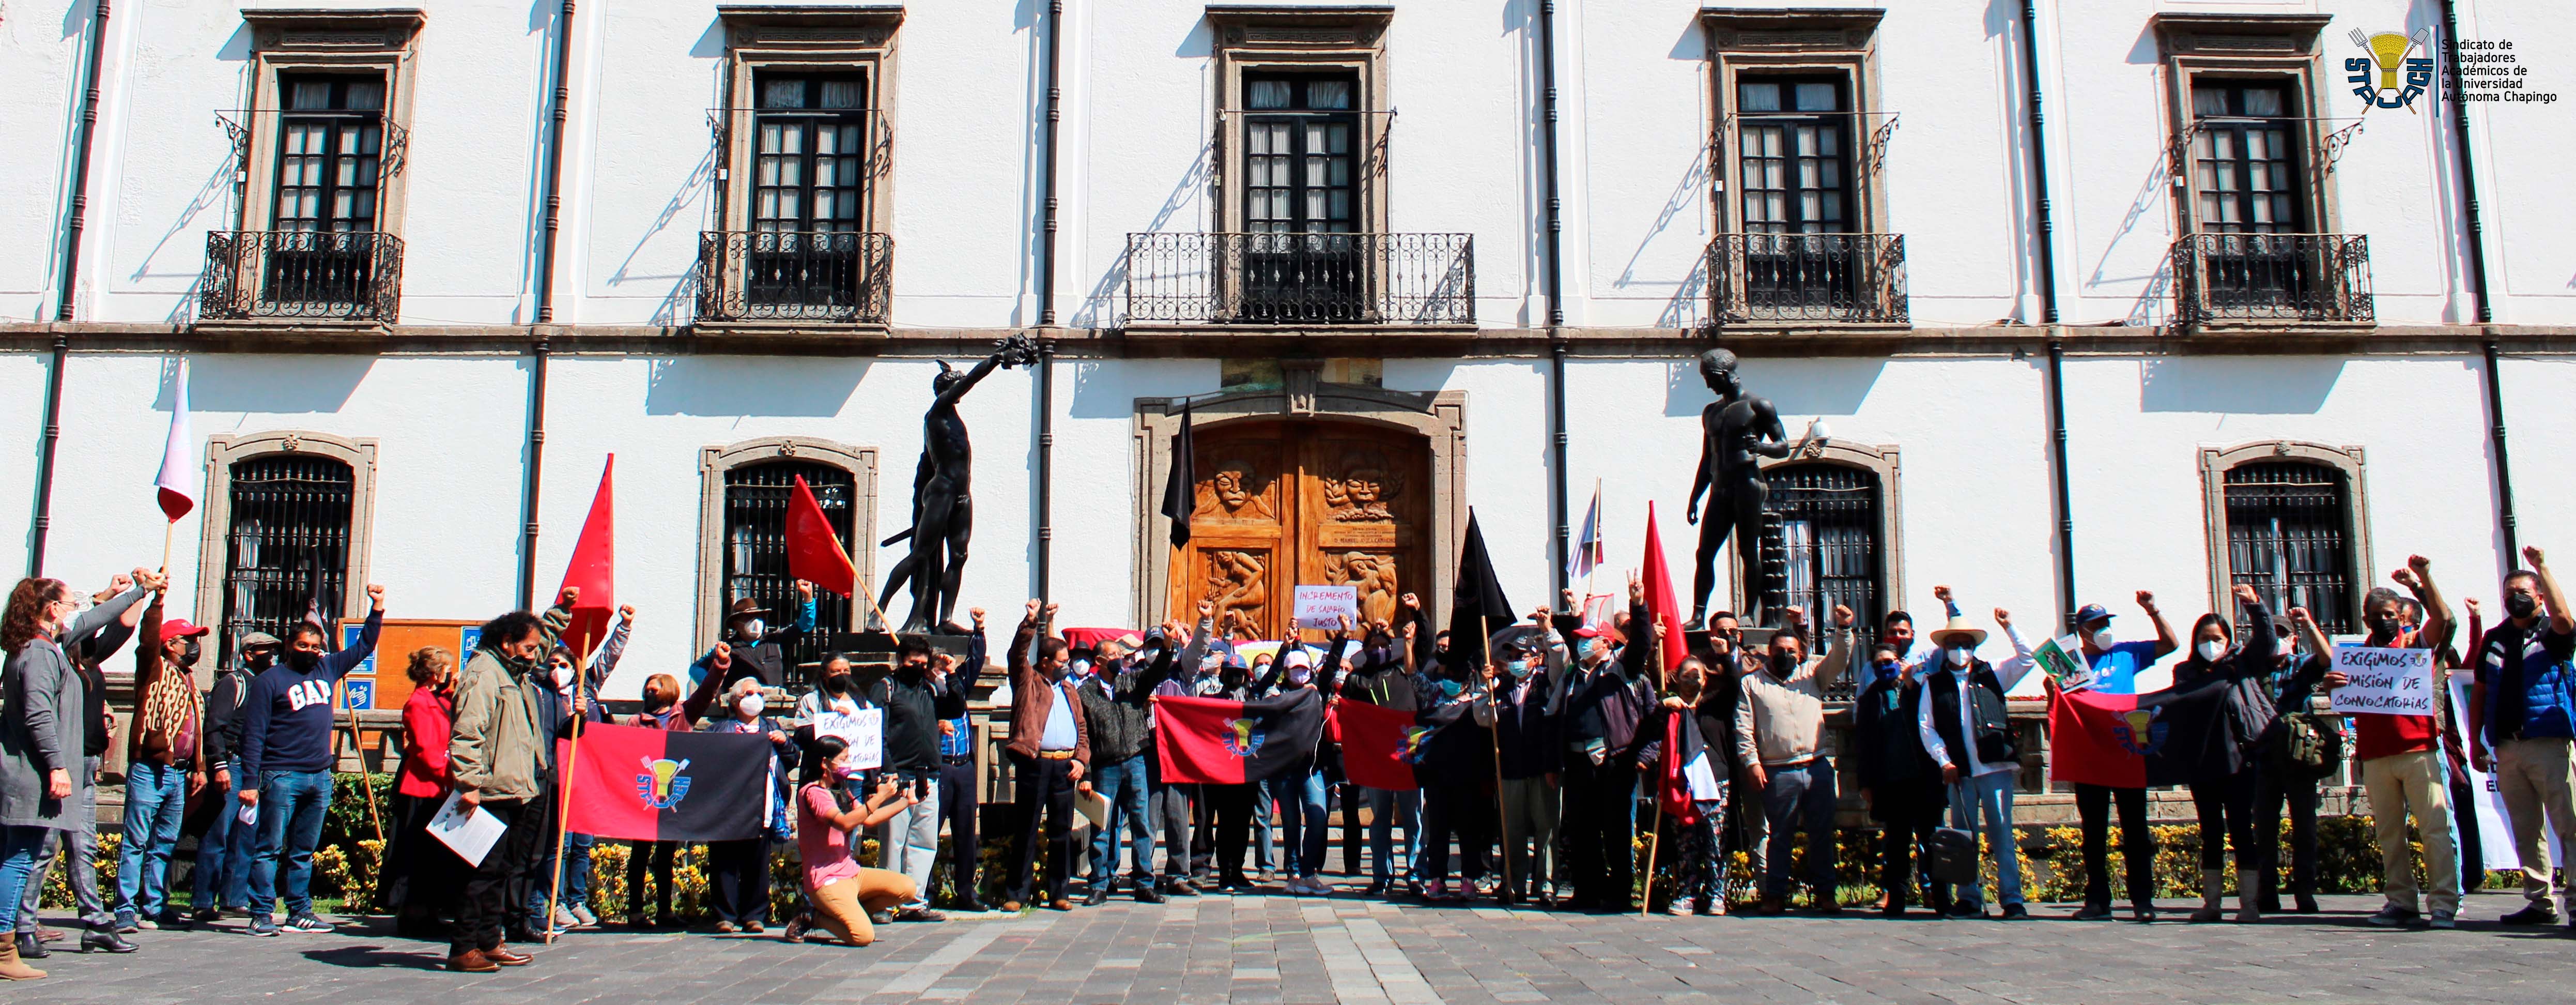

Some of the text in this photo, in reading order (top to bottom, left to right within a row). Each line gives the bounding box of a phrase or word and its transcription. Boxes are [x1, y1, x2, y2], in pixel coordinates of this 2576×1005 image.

[1300, 591, 1353, 601] INCREMENTO
[1306, 605, 1316, 613] DE
[2403, 677, 2420, 690] DE
[287, 678, 332, 711] GAP
[865, 734, 875, 747] DE
